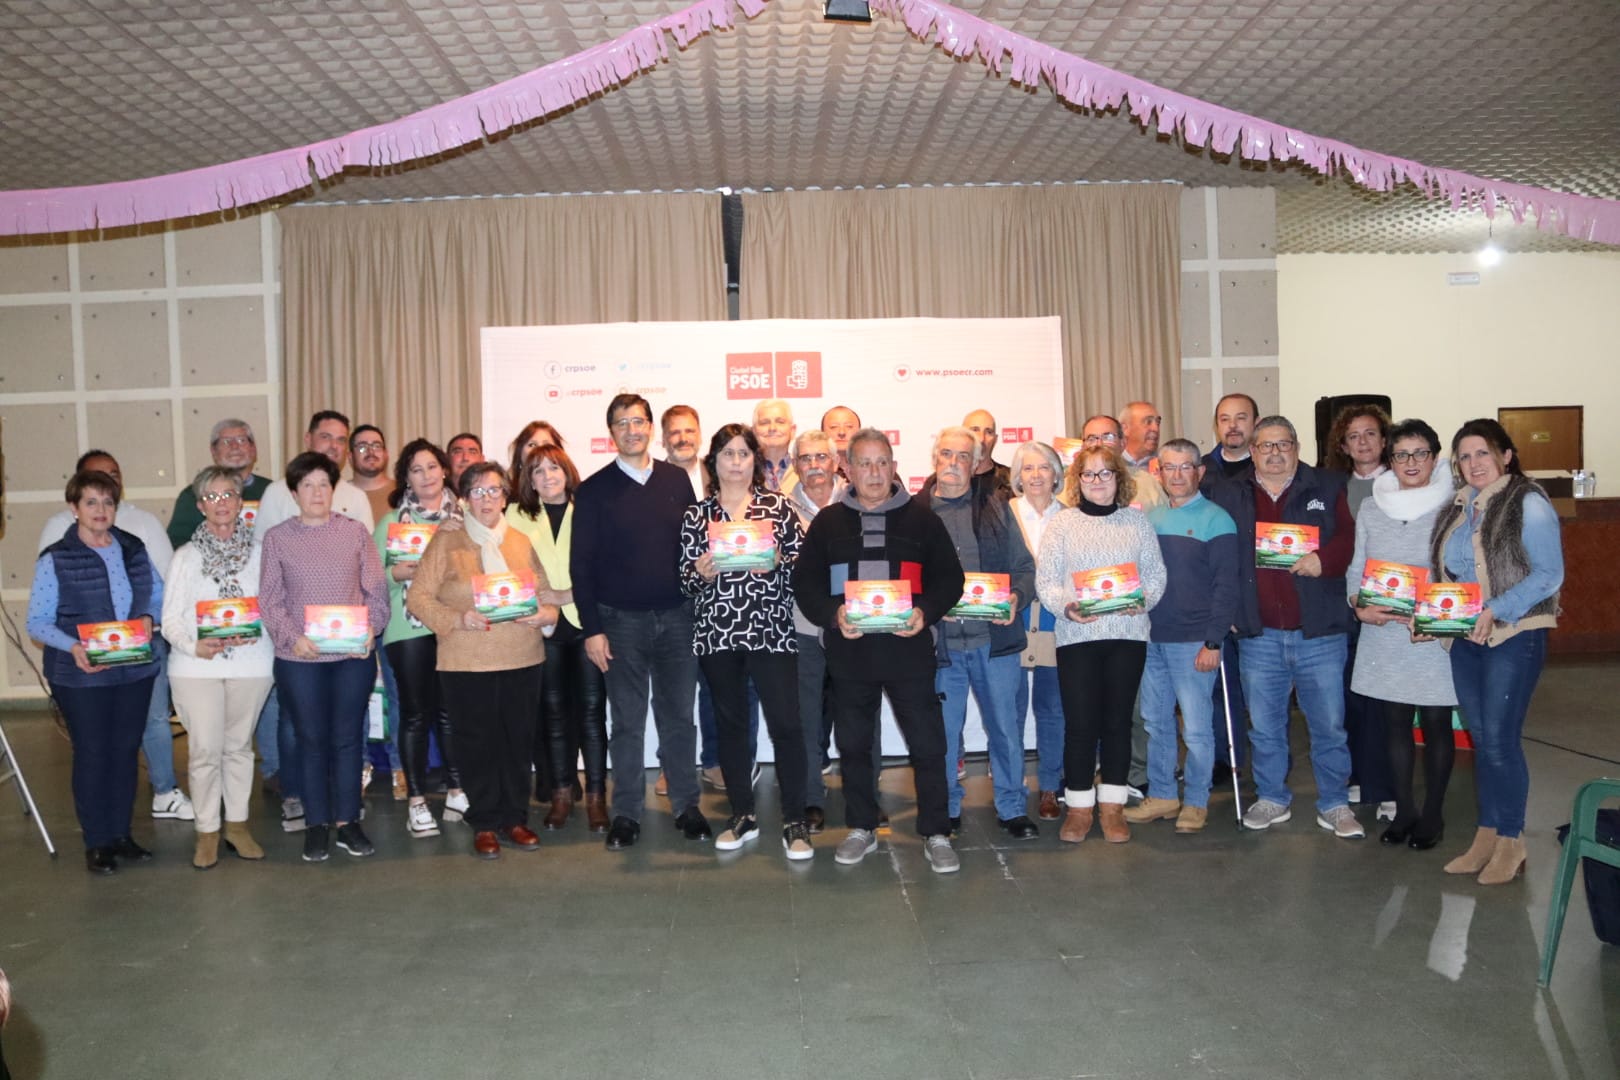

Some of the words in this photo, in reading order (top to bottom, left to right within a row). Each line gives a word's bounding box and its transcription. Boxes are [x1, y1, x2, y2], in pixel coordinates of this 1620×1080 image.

[564, 365, 596, 374] crpsoe
[915, 368, 993, 377] www.psoecr.com
[730, 373, 771, 390] PSOE
